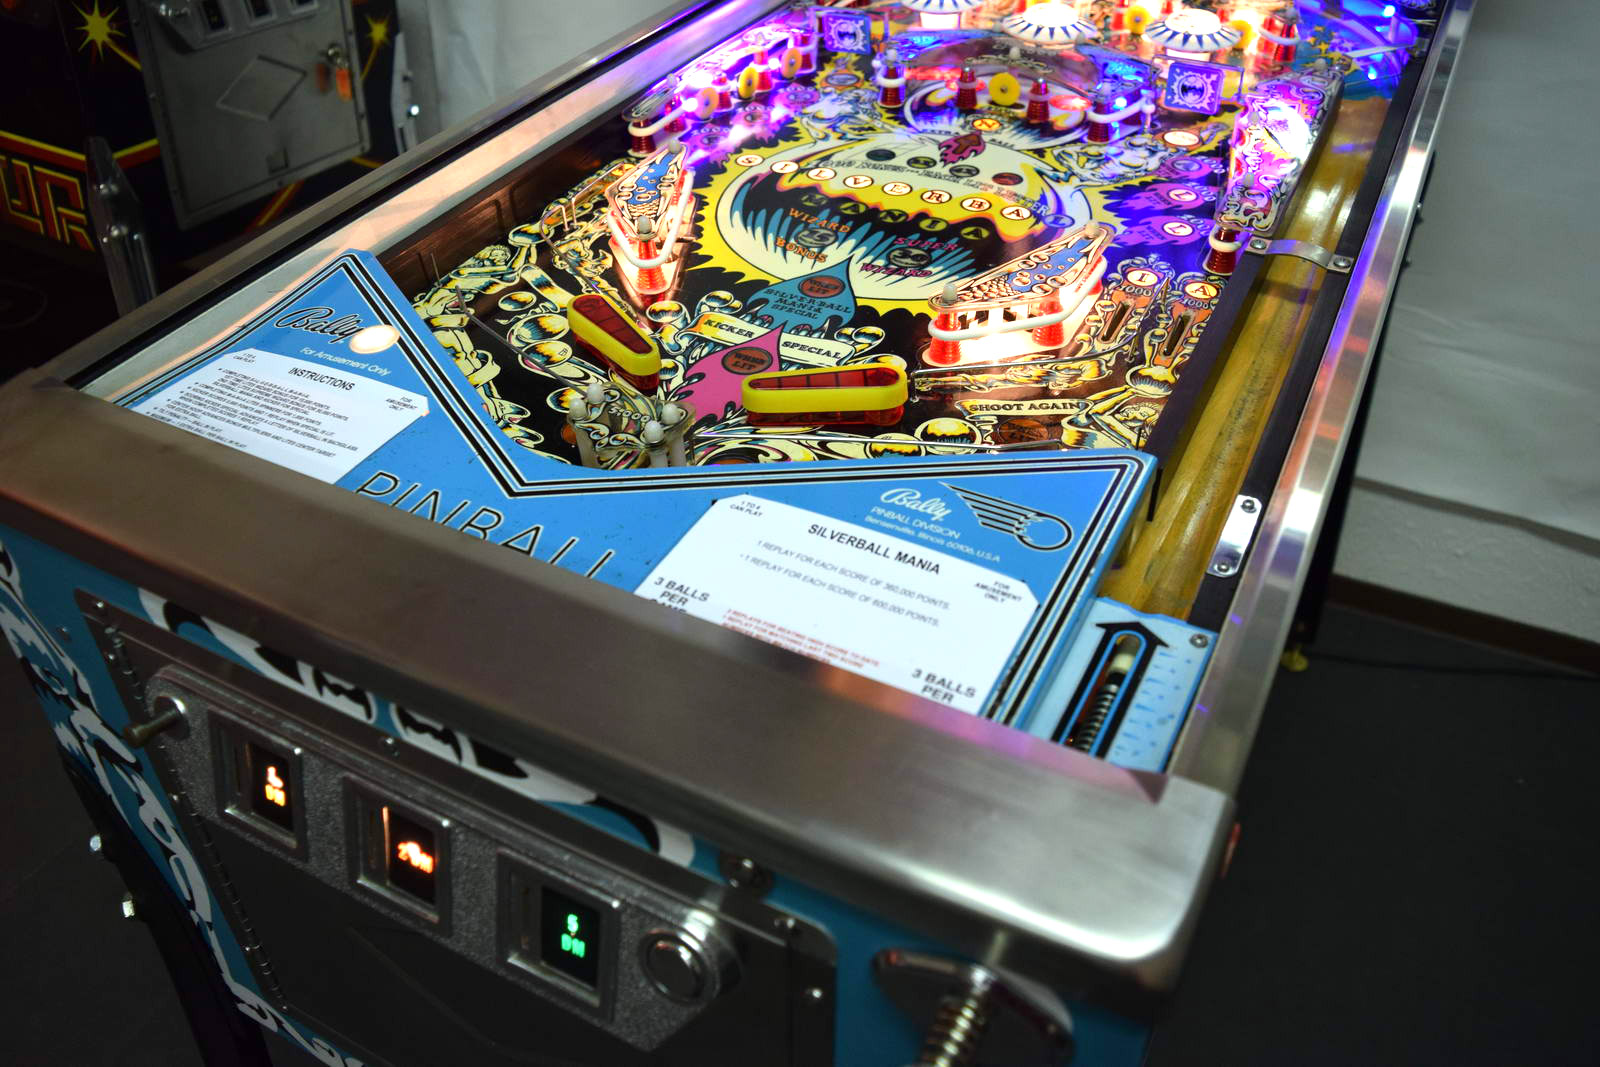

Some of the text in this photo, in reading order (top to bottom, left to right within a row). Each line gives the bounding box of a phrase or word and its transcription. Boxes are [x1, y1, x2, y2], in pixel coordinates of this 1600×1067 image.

[789, 207, 851, 233] WIZARD
[775, 236, 828, 264] BONUS
[894, 237, 959, 252] SUPER
[861, 263, 933, 278] WIZARD
[764, 288, 851, 313] SILVERBALL
[770, 304, 818, 320] SPECIAL
[775, 298, 822, 314] MANIA
[274, 306, 365, 344] Bally
[704, 319, 755, 338] KICKER
[300, 347, 391, 377] For Amusement Only
[781, 341, 842, 359] SPECIAL
[288, 367, 356, 391] INSTRUCTIONS
[968, 401, 1081, 412] SHOOT AGAIN
[880, 488, 952, 521] Bally
[871, 506, 961, 540] PINBALL DIVISION
[808, 523, 941, 575] SILVERBALL MANIA
[763, 541, 794, 558] REPLAY
[796, 552, 814, 565] FOR
[814, 559, 838, 573] EACH
[839, 566, 869, 583] SCORE
[869, 577, 882, 587] OF
[653, 577, 710, 602] 3 BALLS
[750, 555, 782, 573] REPLAY
[783, 568, 803, 581] FOR
[802, 574, 826, 588] EACH
[827, 582, 858, 599] SCORE
[858, 594, 871, 603] OF
[660, 591, 689, 607] PER
[911, 668, 977, 698] 3 BALLS
[921, 684, 955, 703] PER
[567, 913, 579, 933] 5
